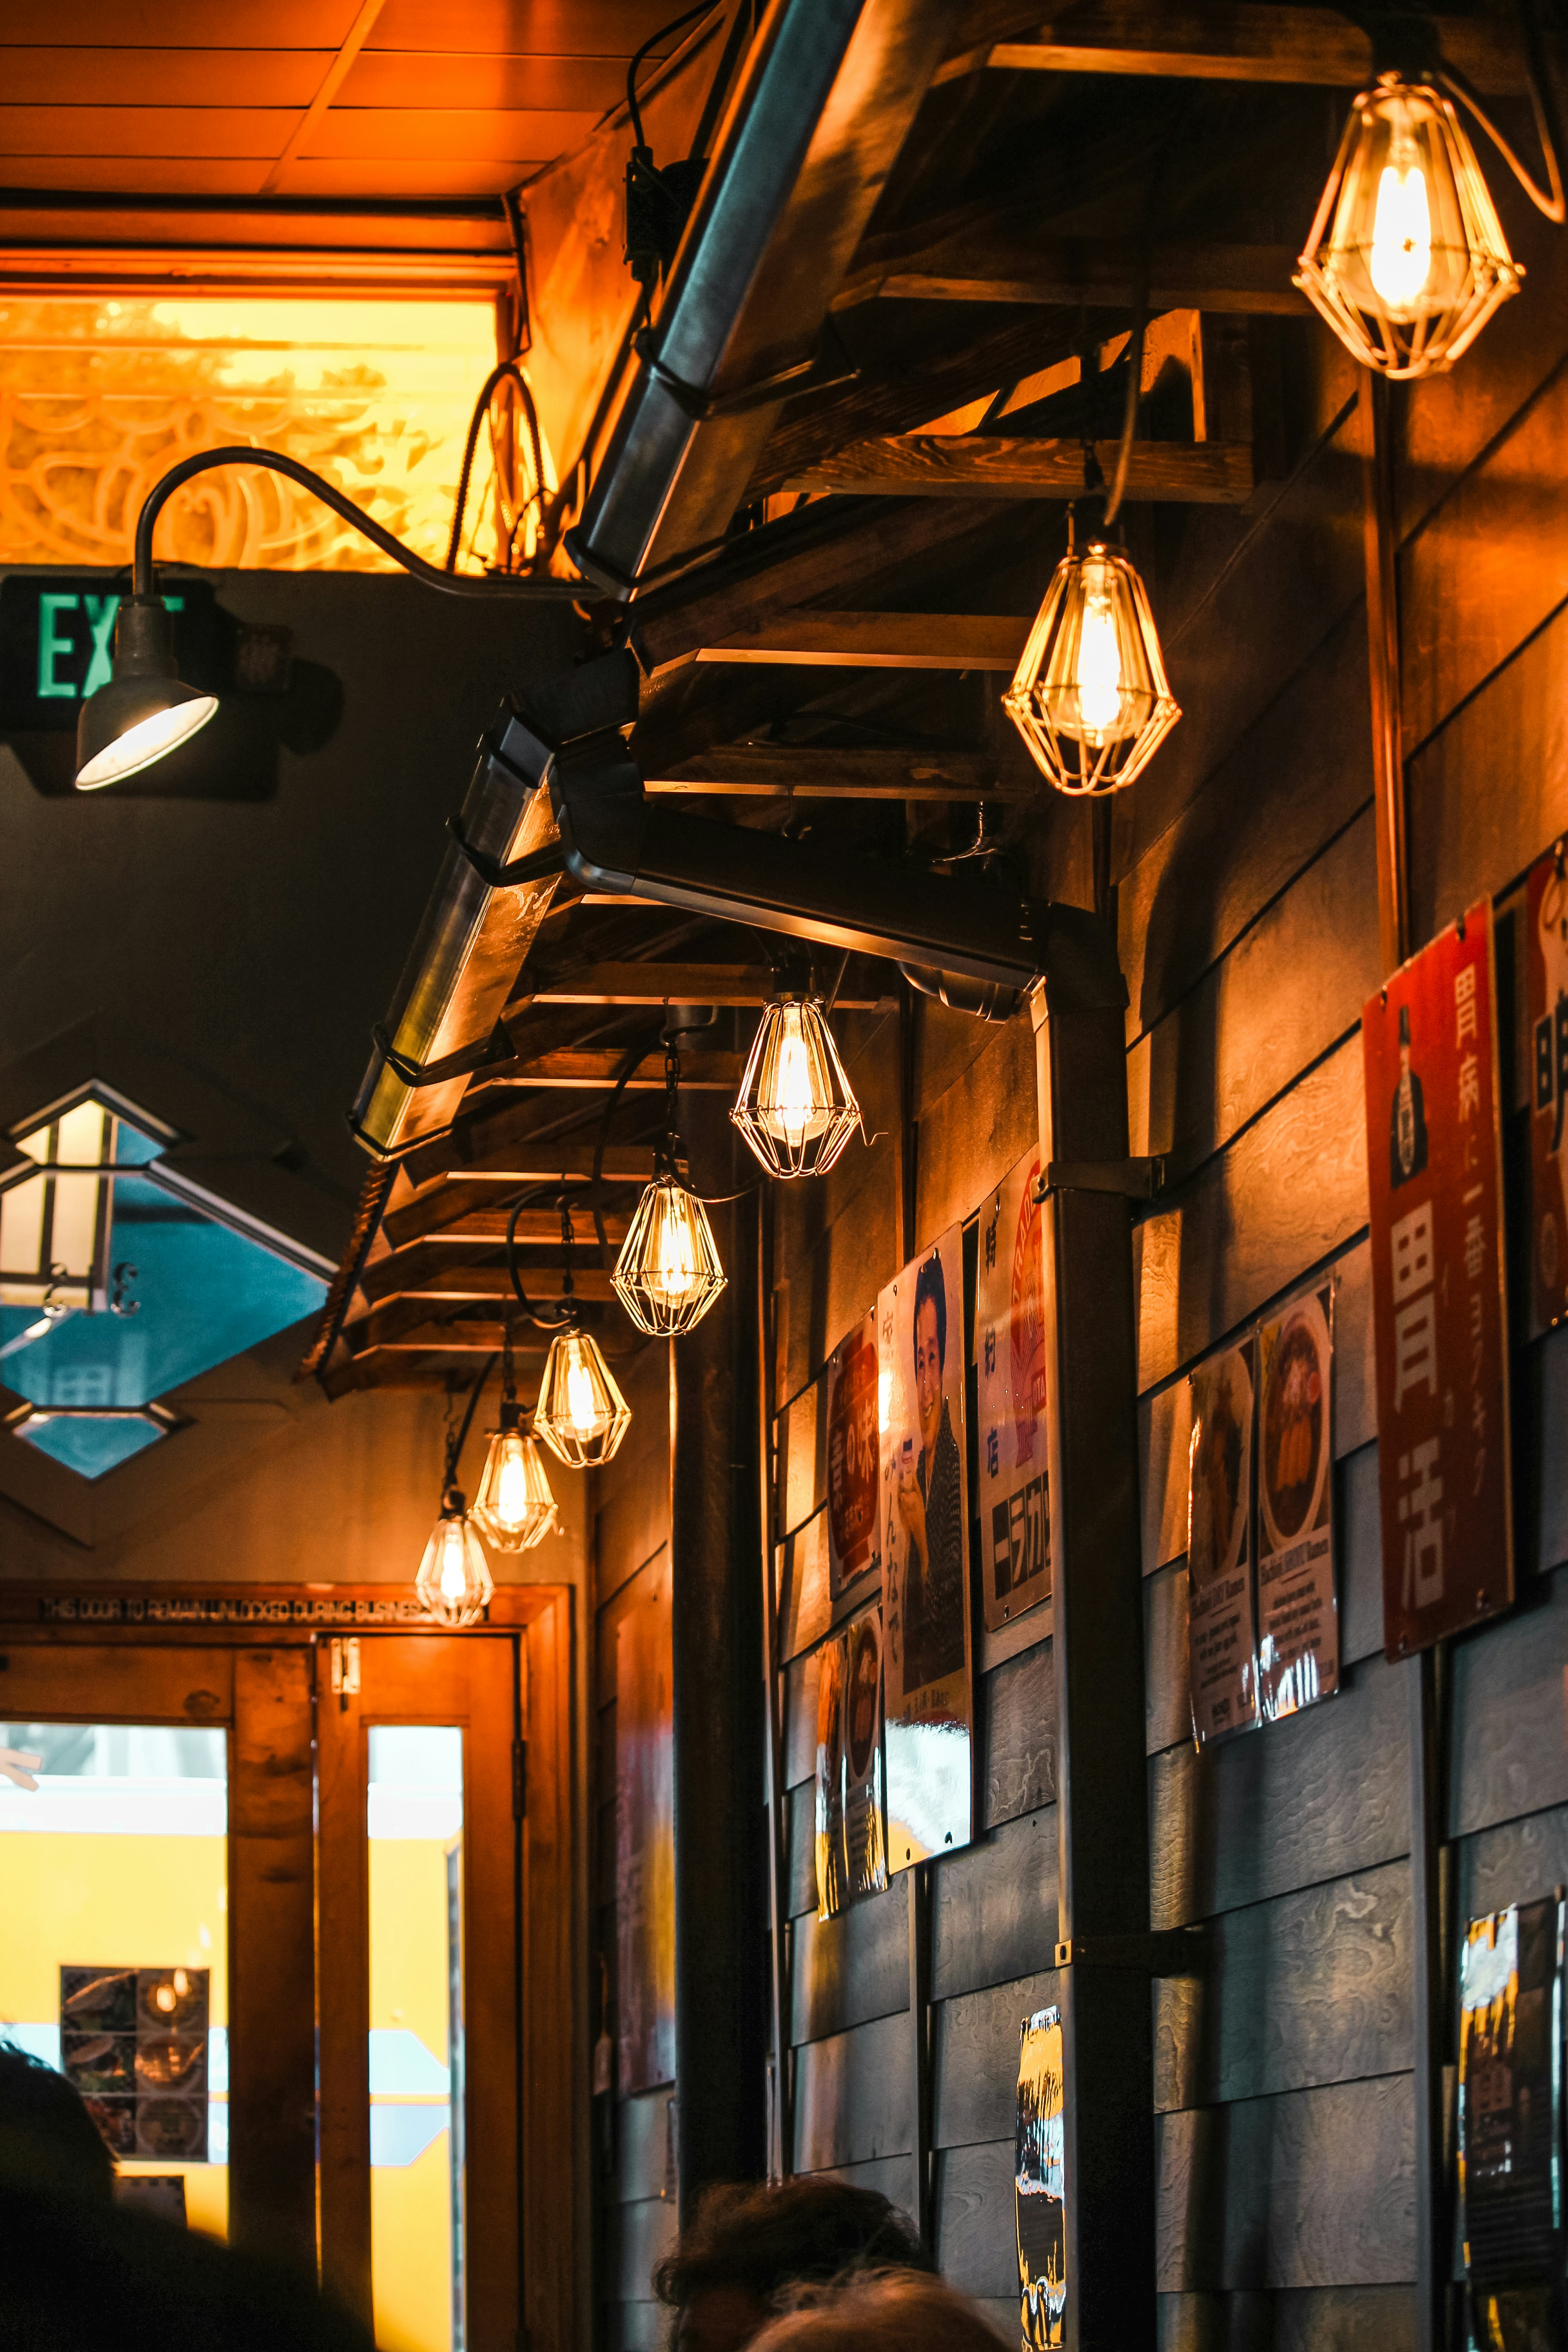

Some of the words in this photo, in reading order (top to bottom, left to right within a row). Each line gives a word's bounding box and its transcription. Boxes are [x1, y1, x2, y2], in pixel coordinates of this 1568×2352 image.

[37, 593, 185, 699] EX
[1390, 1199, 1444, 1611] 胃活
[79, 1597, 121, 1620] DOOR
[127, 1598, 144, 1620] TO
